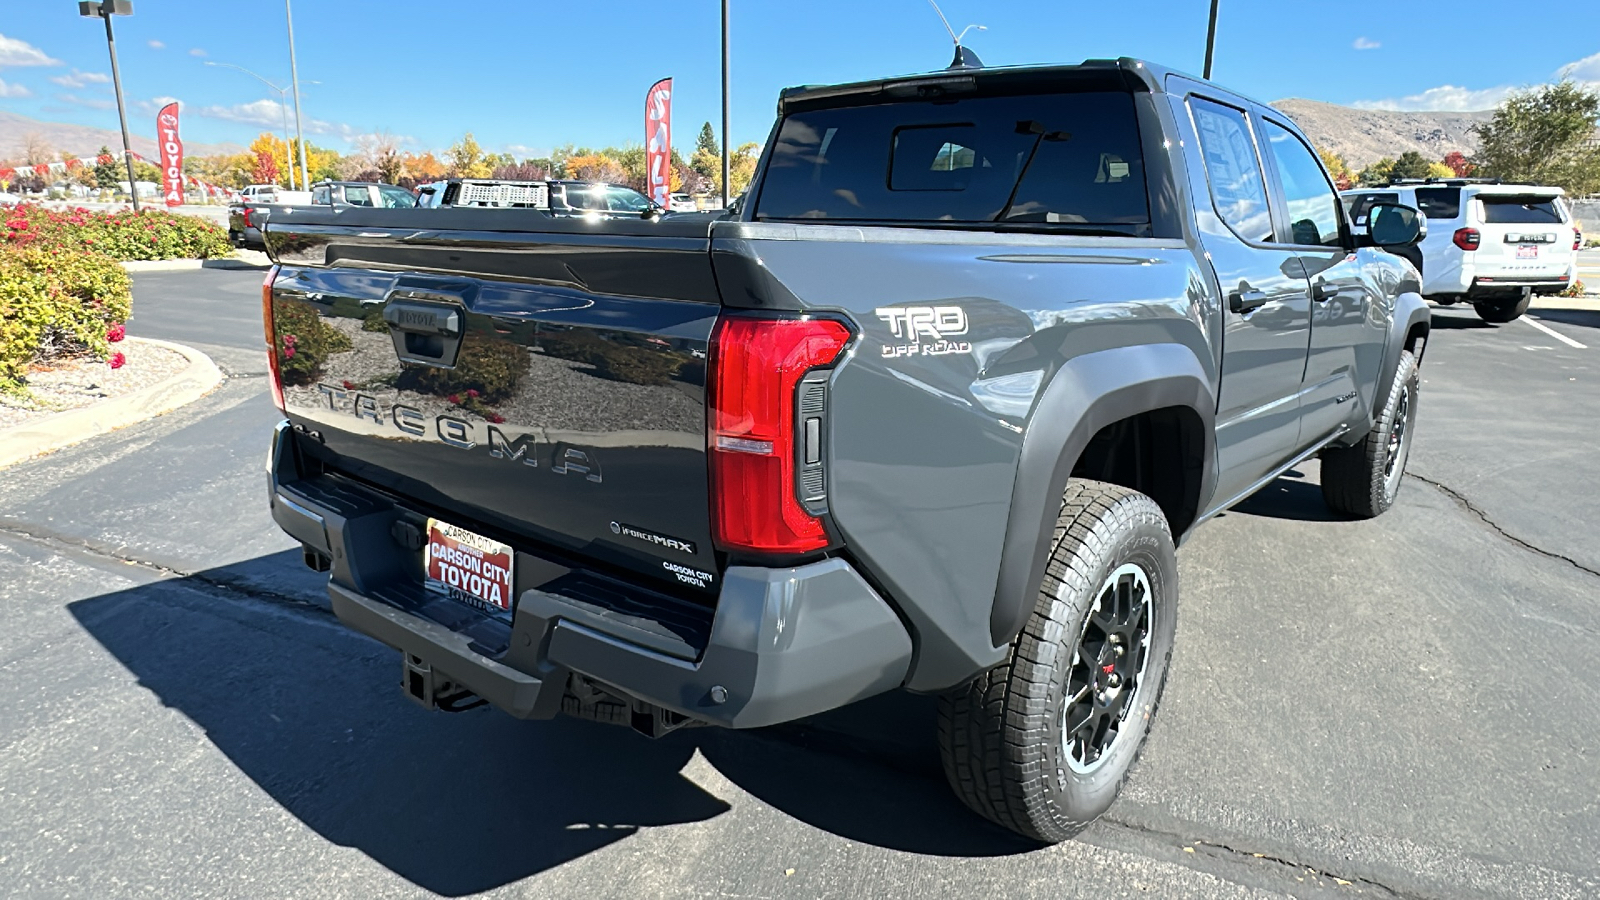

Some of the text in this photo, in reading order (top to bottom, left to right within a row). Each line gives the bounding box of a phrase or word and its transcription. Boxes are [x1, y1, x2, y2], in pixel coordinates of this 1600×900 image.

[163, 128, 180, 202] TOYOTA
[876, 306, 968, 344] TRD
[881, 340, 973, 358] OFF ROAD
[317, 382, 602, 483] TACOMA
[447, 526, 494, 552] CARSON CITY
[431, 541, 511, 586] CARSON CITY
[662, 561, 713, 583] CARSON CITY
[675, 573, 706, 588] TOYOTA
[438, 561, 503, 607] TOYOTA
